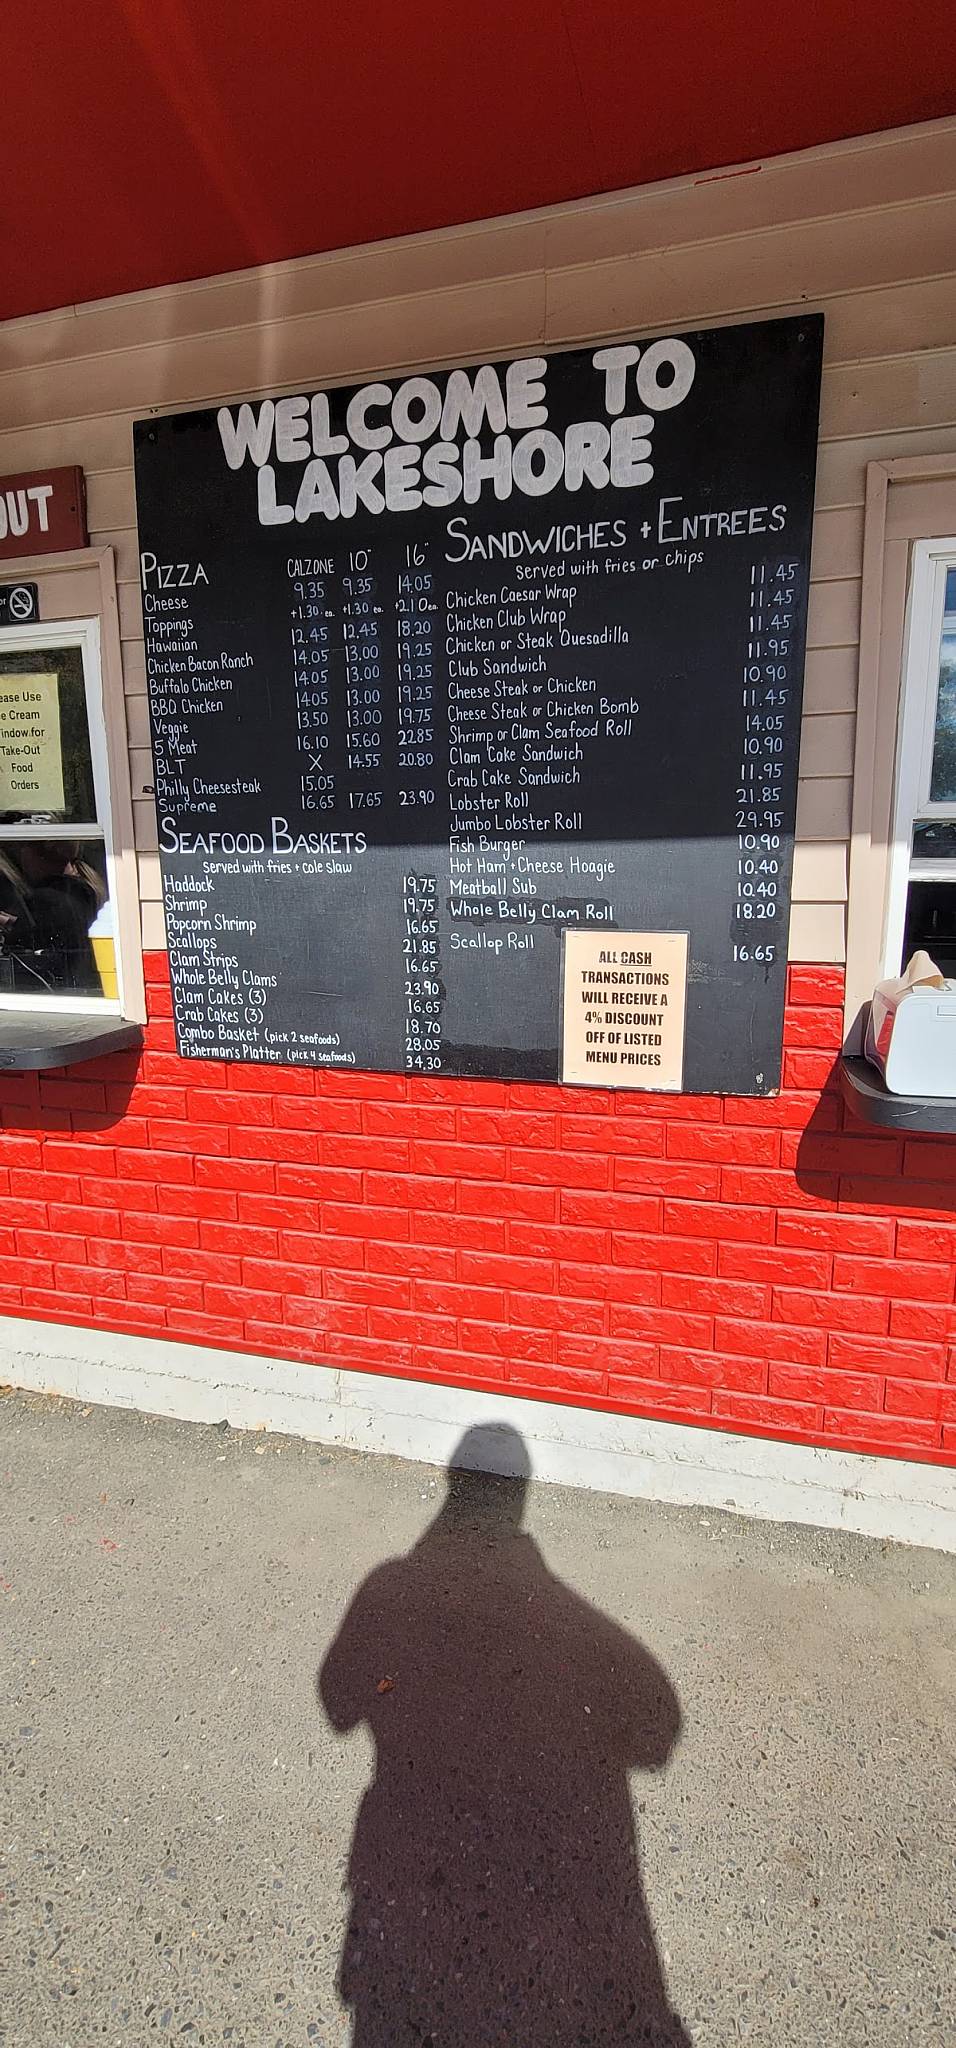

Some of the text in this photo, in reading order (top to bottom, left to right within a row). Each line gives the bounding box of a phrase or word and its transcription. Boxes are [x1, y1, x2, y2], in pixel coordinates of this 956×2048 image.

[217, 338, 696, 469] WELCOME TO
[257, 415, 655, 526] LAKESHORE
[445, 496, 787, 562] SANDWICHES ENTREES
[141, 552, 209, 590] PIZZA
[288, 558, 335, 577] CALZONE
[570, 560, 599, 574] with
[605, 558, 636, 573] fries
[643, 557, 659, 570] or
[665, 550, 704, 573] chips
[398, 574, 432, 594] 14.05
[145, 593, 189, 612] Cheese
[446, 583, 577, 608] Chicken Caesar Wrap
[145, 617, 193, 638] Toppings
[447, 606, 566, 632] Chicken Club Wrap
[750, 614, 792, 632] 11.45
[398, 620, 431, 637] 18.20
[147, 638, 197, 654] Hawaiian
[398, 642, 432, 659] 19.25
[446, 636, 495, 655] Chicken
[501, 639, 512, 650] or
[517, 631, 554, 650] Steak
[148, 652, 253, 674] Chicken Bacon Ranch
[448, 654, 547, 677] Club Sandwich
[346, 665, 380, 684] 13.00
[150, 676, 232, 695] Buffalo Chicken
[398, 686, 433, 703] 19.25
[23, 692, 41, 701] Use
[743, 689, 789, 707] 11.45
[9, 710, 40, 720] Cream
[399, 708, 432, 725] 19.75
[448, 697, 639, 722] Cheese Steak or Chicken Bomb
[31, 727, 45, 736] for
[153, 719, 189, 742] Veggie
[449, 719, 632, 750] Shrimp or Clam Seafood Roll
[154, 740, 197, 755] 5 Meat
[347, 733, 380, 748] 15.60
[744, 737, 783, 754] 10.90
[2, 745, 40, 756] Take-Out
[449, 742, 583, 765] Clam Cake Sandwich
[12, 763, 33, 772] Food
[156, 759, 186, 775] BLT
[11, 780, 39, 790] Orders
[301, 775, 334, 792] 15.05
[448, 766, 580, 788] Crab Cake Sandwich
[157, 778, 261, 802] Philly Cheesesteak
[399, 790, 434, 806] 23.90
[159, 798, 216, 815] Supreme
[450, 792, 529, 811] Lobster Roll
[450, 812, 582, 832] Jumbo Lobster Roll
[735, 811, 784, 828] 29.95
[159, 817, 367, 854] SEAFOOD BASKETS
[450, 835, 526, 861] Fish Burger
[203, 859, 352, 873] served with fries cole slaw
[450, 856, 616, 881] Hot Ham Cheese Hoagie
[164, 875, 215, 893] Haddock
[450, 877, 537, 895] Meatball Sub
[738, 882, 777, 897] 10.40
[165, 894, 207, 916] Shrimp
[403, 898, 435, 913] 19.75
[451, 900, 613, 924] Whole Belly Clam Roll
[167, 913, 256, 936] Popcorn Shrimp
[169, 932, 217, 950] Scallops
[450, 932, 534, 955] Scallop Roll
[170, 951, 238, 968] Clam Strips
[599, 951, 652, 966] ALL CASH
[734, 945, 775, 961] 16.65
[405, 958, 438, 974] 16.65
[171, 968, 277, 989] Whole Belly Clams
[582, 971, 669, 985] TRANSACTIONS
[174, 987, 267, 1006] Clam Cakes (3)
[582, 991, 668, 1006] WILL RECEIVE A
[175, 1005, 263, 1024] Crab Cakes (3)
[585, 1012, 664, 1026] 4% DISCOUNT
[178, 1023, 340, 1045] Combo Basket (pick 2 seafoods)
[405, 1019, 440, 1034] 18.70
[586, 1032, 662, 1046] OFF OF LISTED
[180, 1040, 356, 1063] Fisherman's Platter (pick 4 seafoods)
[586, 1051, 661, 1066] MENU PRICES
[406, 1055, 441, 1070] 34.30
